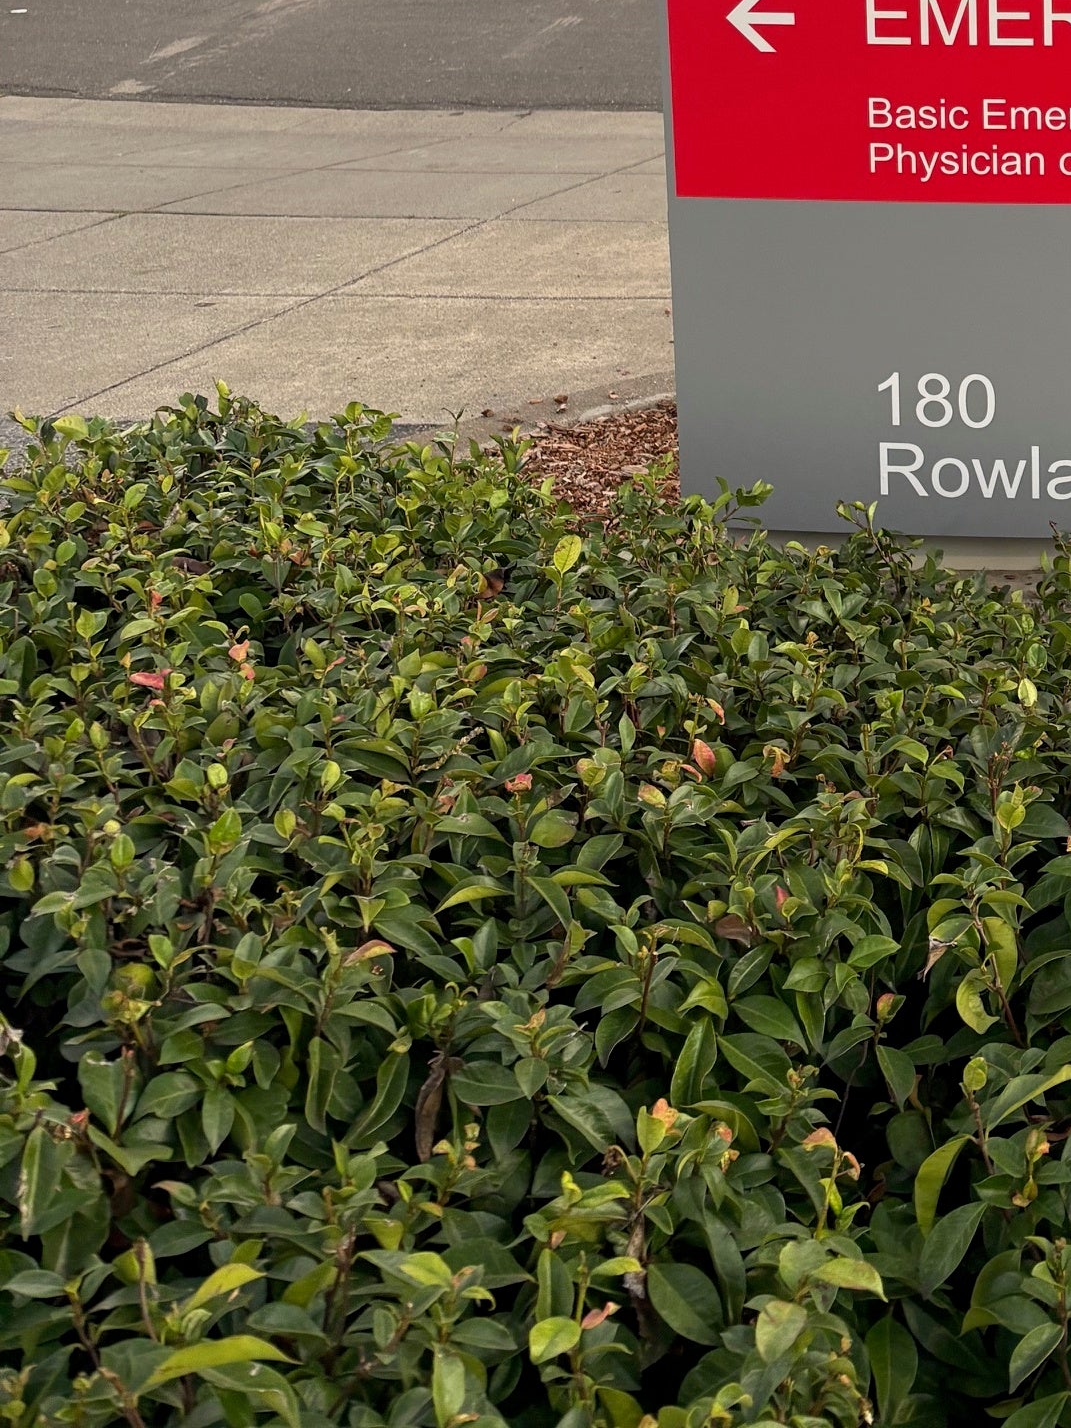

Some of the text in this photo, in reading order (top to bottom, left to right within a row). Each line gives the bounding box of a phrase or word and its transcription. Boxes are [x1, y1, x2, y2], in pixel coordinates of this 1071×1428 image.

[868, 97, 969, 130] Basic
[869, 142, 1045, 183] Physician
[877, 371, 996, 429] 180
